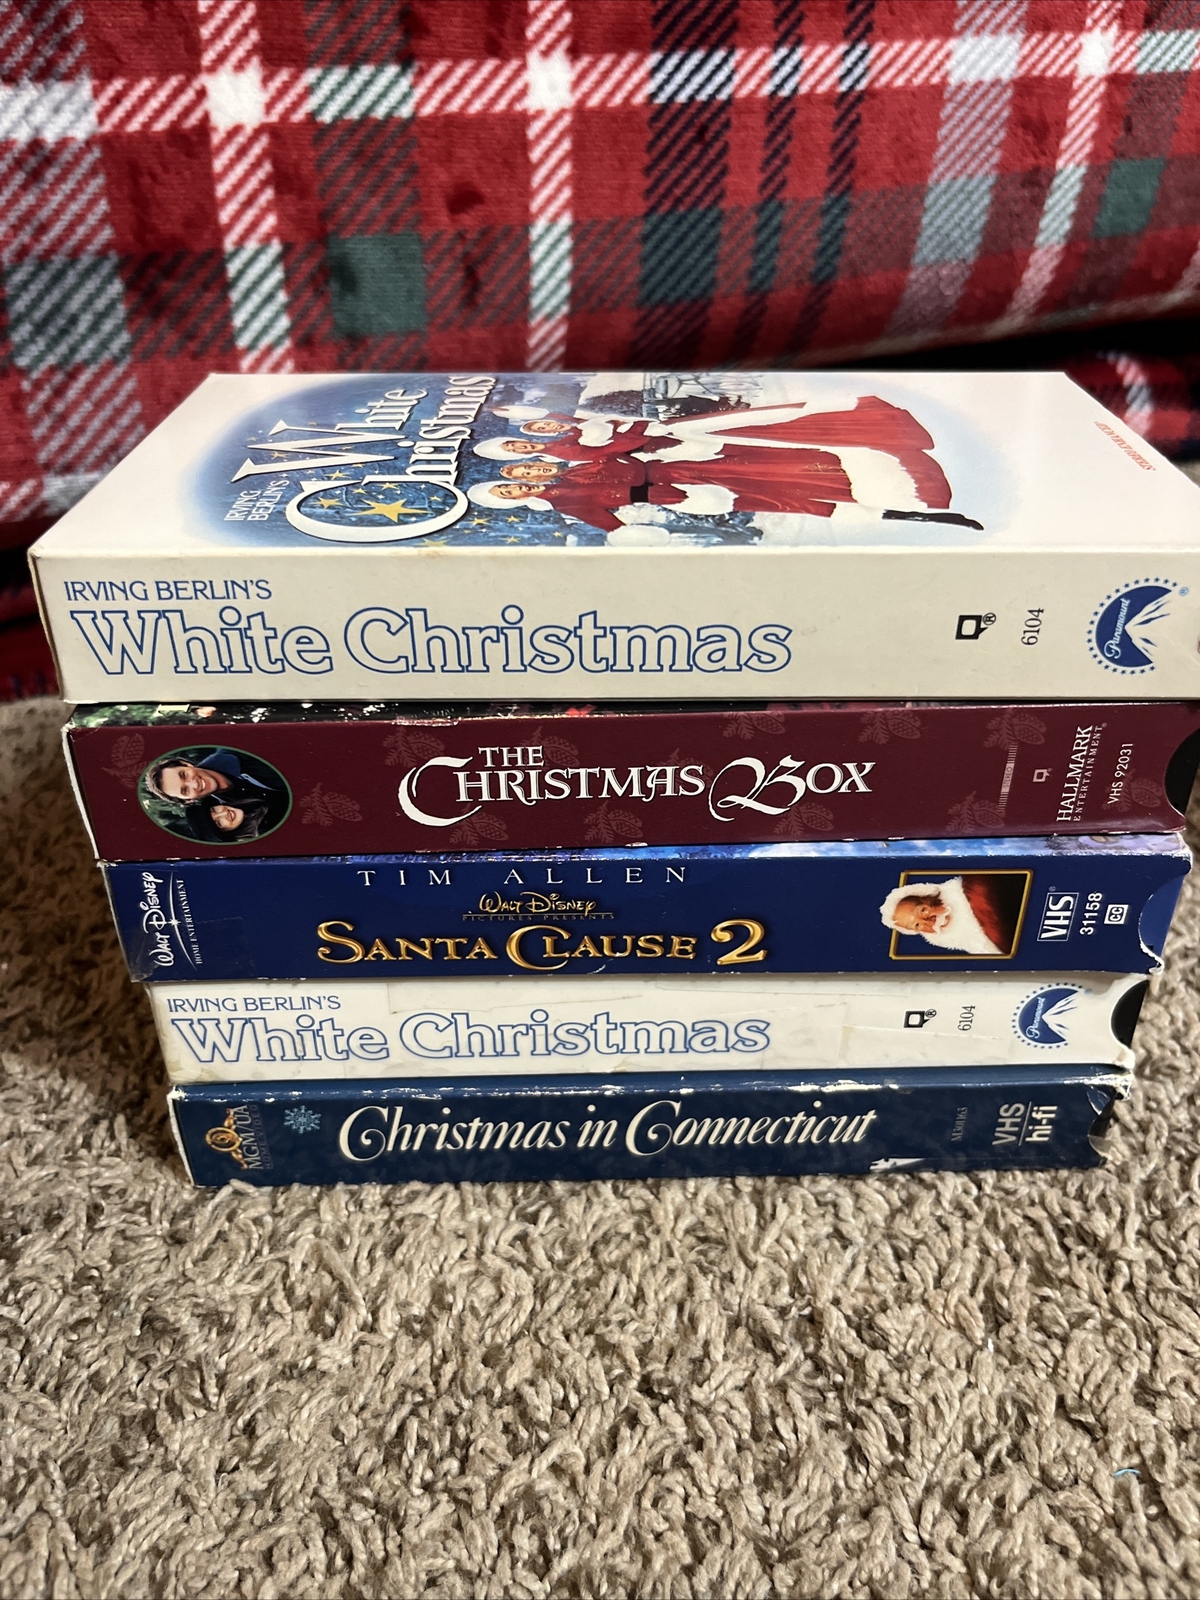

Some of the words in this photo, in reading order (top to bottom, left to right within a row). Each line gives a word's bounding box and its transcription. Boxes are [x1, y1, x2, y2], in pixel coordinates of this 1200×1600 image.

[231, 388, 427, 482] White
[286, 375, 496, 543] Christmas
[224, 490, 261, 521] IRVING
[247, 480, 290, 521] BERLIN'S
[64, 580, 149, 600] IRVING
[154, 579, 272, 600] BERLIN'S
[70, 605, 334, 675] White
[344, 604, 793, 674] Christmas
[1021, 607, 1044, 646] 6104
[1104, 597, 1130, 659] Paramount
[478, 745, 544, 767] THE
[1002, 765, 1014, 789] STEREO
[1056, 725, 1093, 822] HALLMARK
[1073, 725, 1103, 822] ENTERTAINMENT
[1114, 743, 1133, 778] 92031
[398, 756, 706, 826] CHRISTMAS
[709, 755, 876, 822] BOX
[1107, 779, 1124, 805] VHS
[357, 869, 451, 886] TIM
[504, 867, 687, 885] ALLEN
[176, 879, 198, 942] ENTERTAINMENT
[462, 914, 532, 922] PICTURES
[543, 913, 615, 921] PRESENTS
[1040, 894, 1074, 940] VHS
[1080, 892, 1103, 936] 31158
[1110, 906, 1124, 922] CC
[192, 943, 203, 965] HOME
[316, 920, 498, 965] SANTA
[505, 924, 698, 970] CLAUSE
[710, 919, 768, 966] 2
[167, 997, 237, 1013] IRVING
[243, 995, 341, 1012] BERLIN'S
[957, 1004, 976, 1031] 6104
[1025, 996, 1046, 1039] Paramount
[171, 1014, 390, 1063] White
[399, 1008, 771, 1059] Christmas
[233, 1105, 264, 1169] MGM/UA
[339, 1105, 571, 1162] Christmas
[577, 1104, 615, 1149] in
[625, 1100, 877, 1157] Connecticut
[992, 1102, 1024, 1146] VHS
[1026, 1104, 1058, 1142] hi-fi
